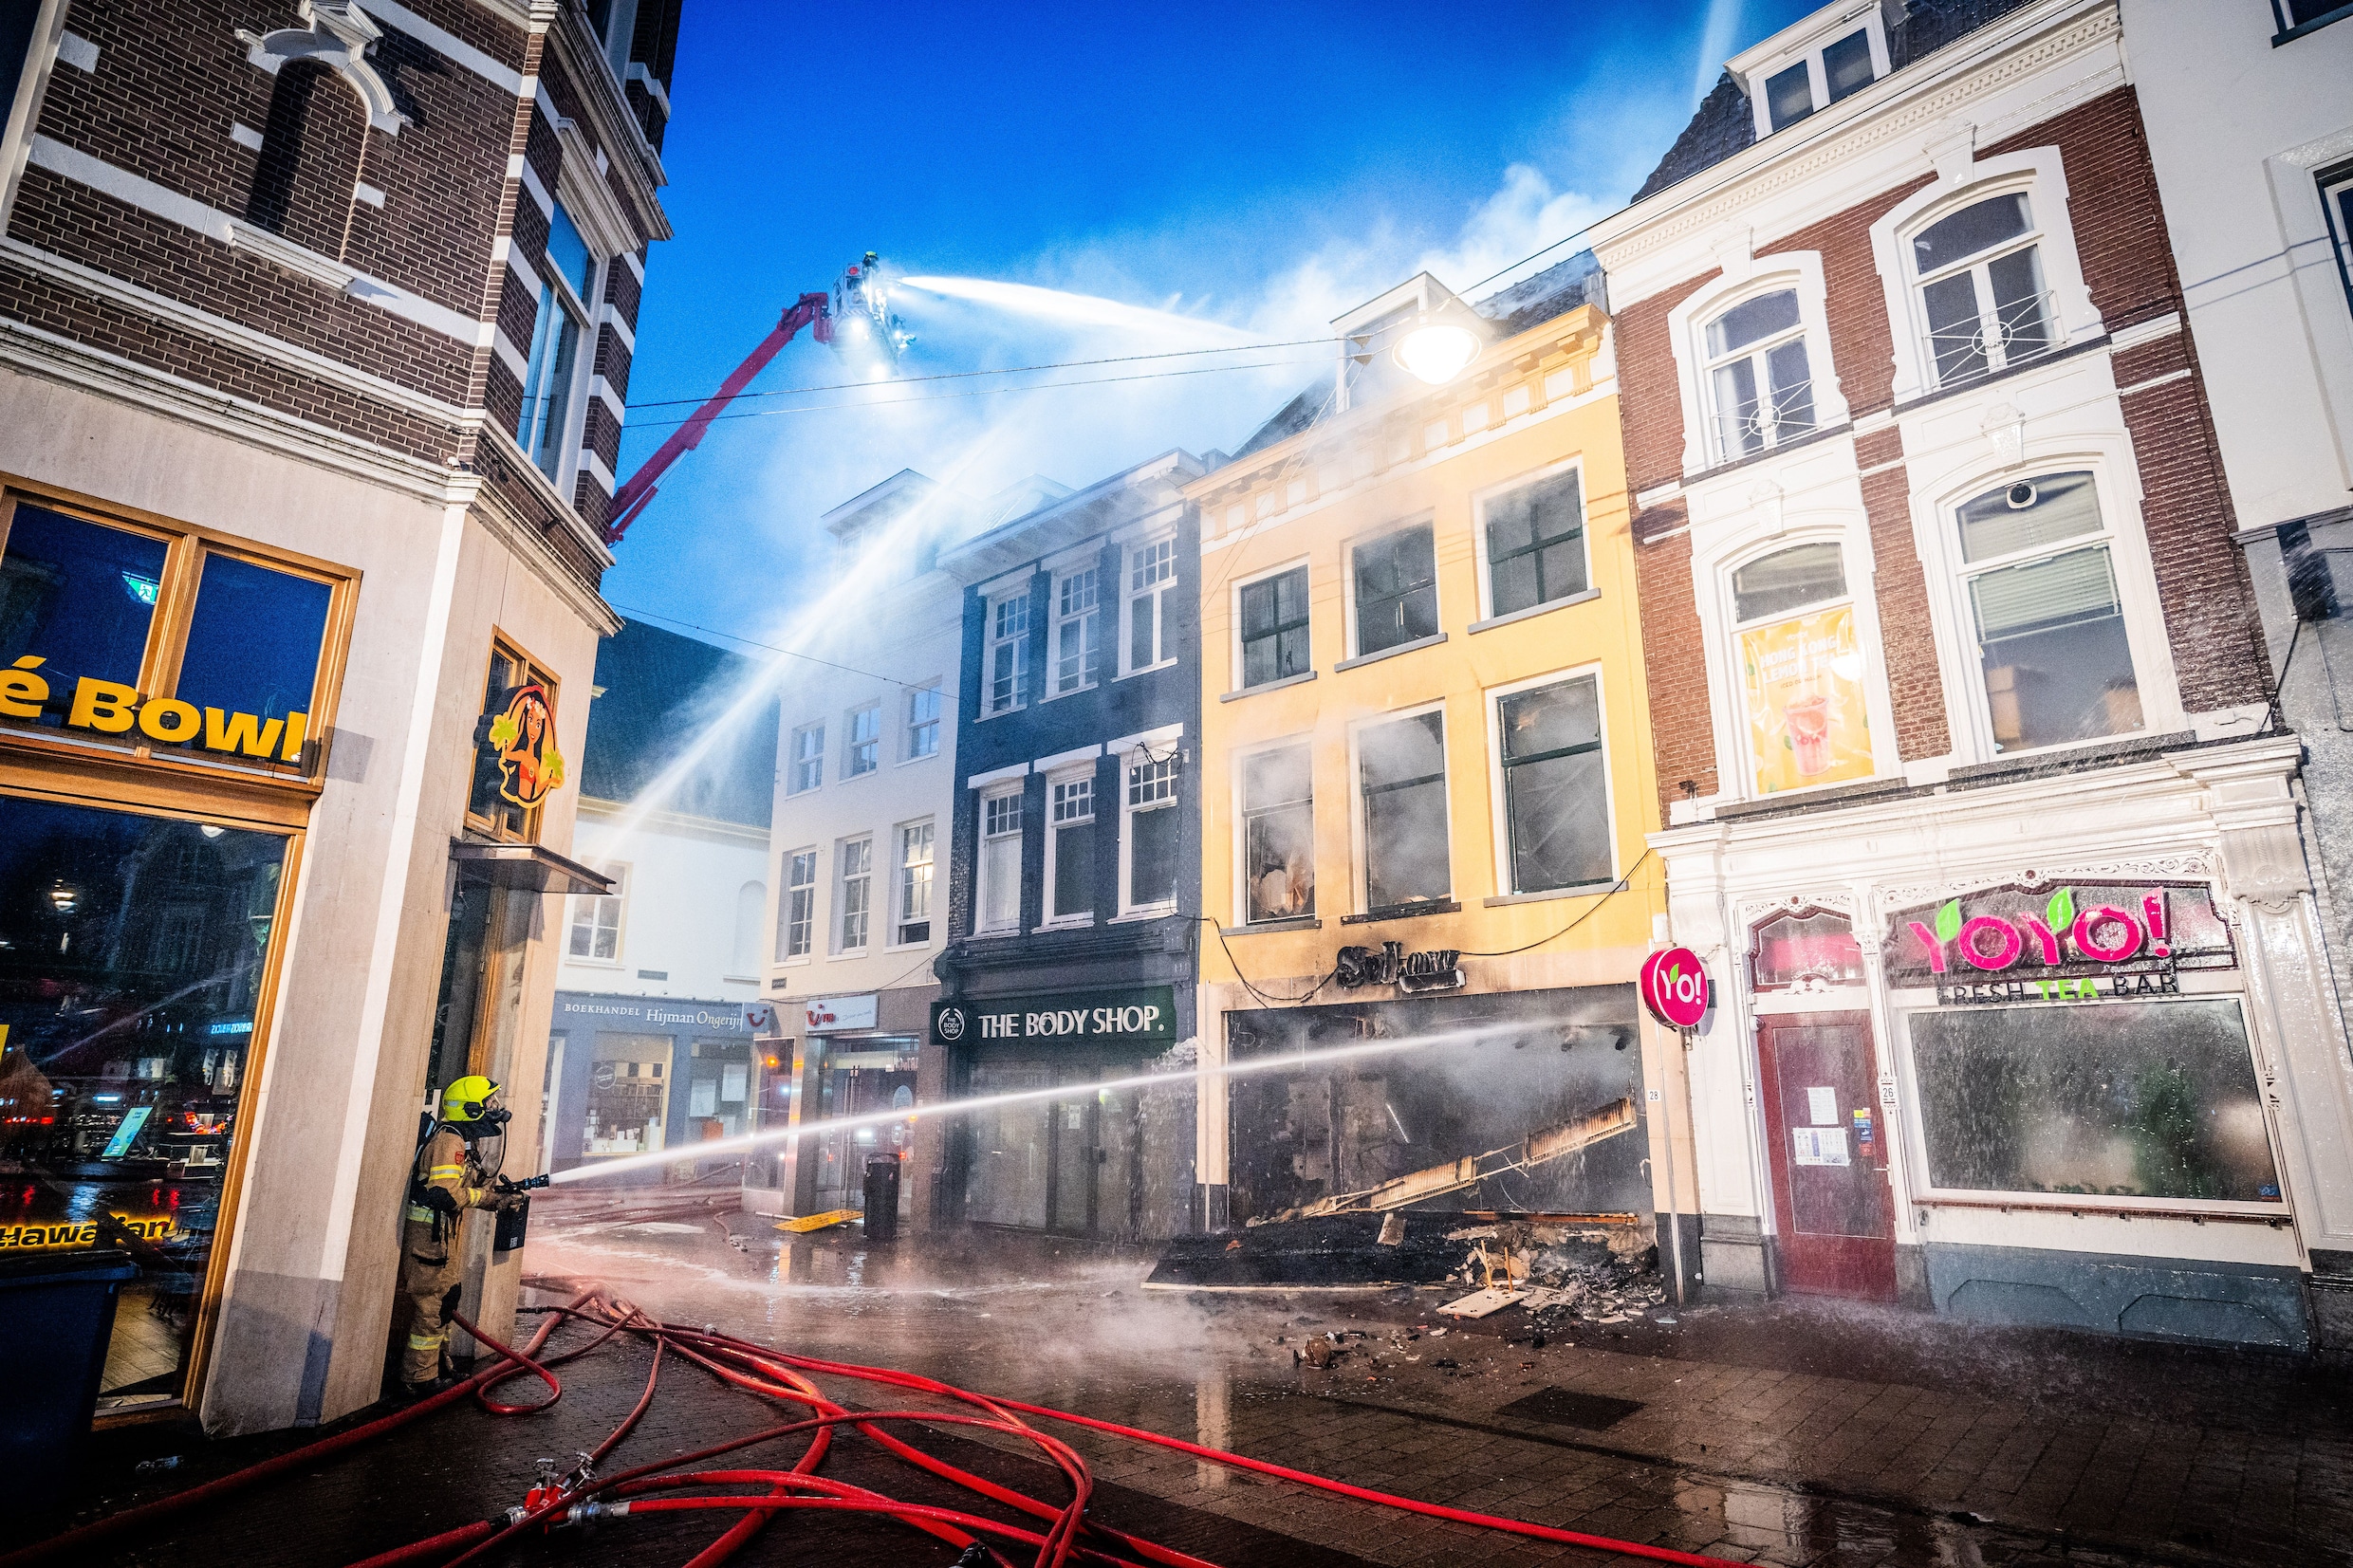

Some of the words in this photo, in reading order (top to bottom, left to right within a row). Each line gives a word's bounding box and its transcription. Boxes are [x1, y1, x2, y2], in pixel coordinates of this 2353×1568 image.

[1760, 646, 1796, 668] HONG
[67, 675, 308, 762] Bowl
[1907, 886, 2171, 973] YOYO!
[1936, 983, 2025, 1005] FRESH
[2035, 978, 2100, 1002] TEA
[2112, 972, 2179, 996] BAR
[564, 1004, 640, 1016] BOEKHANDEL
[646, 1008, 695, 1025] Hijman
[978, 1013, 1020, 1039] THE
[1026, 1009, 1089, 1037] BODY
[1649, 1091, 1658, 1100] 28
[1882, 1087, 1894, 1098] 26
